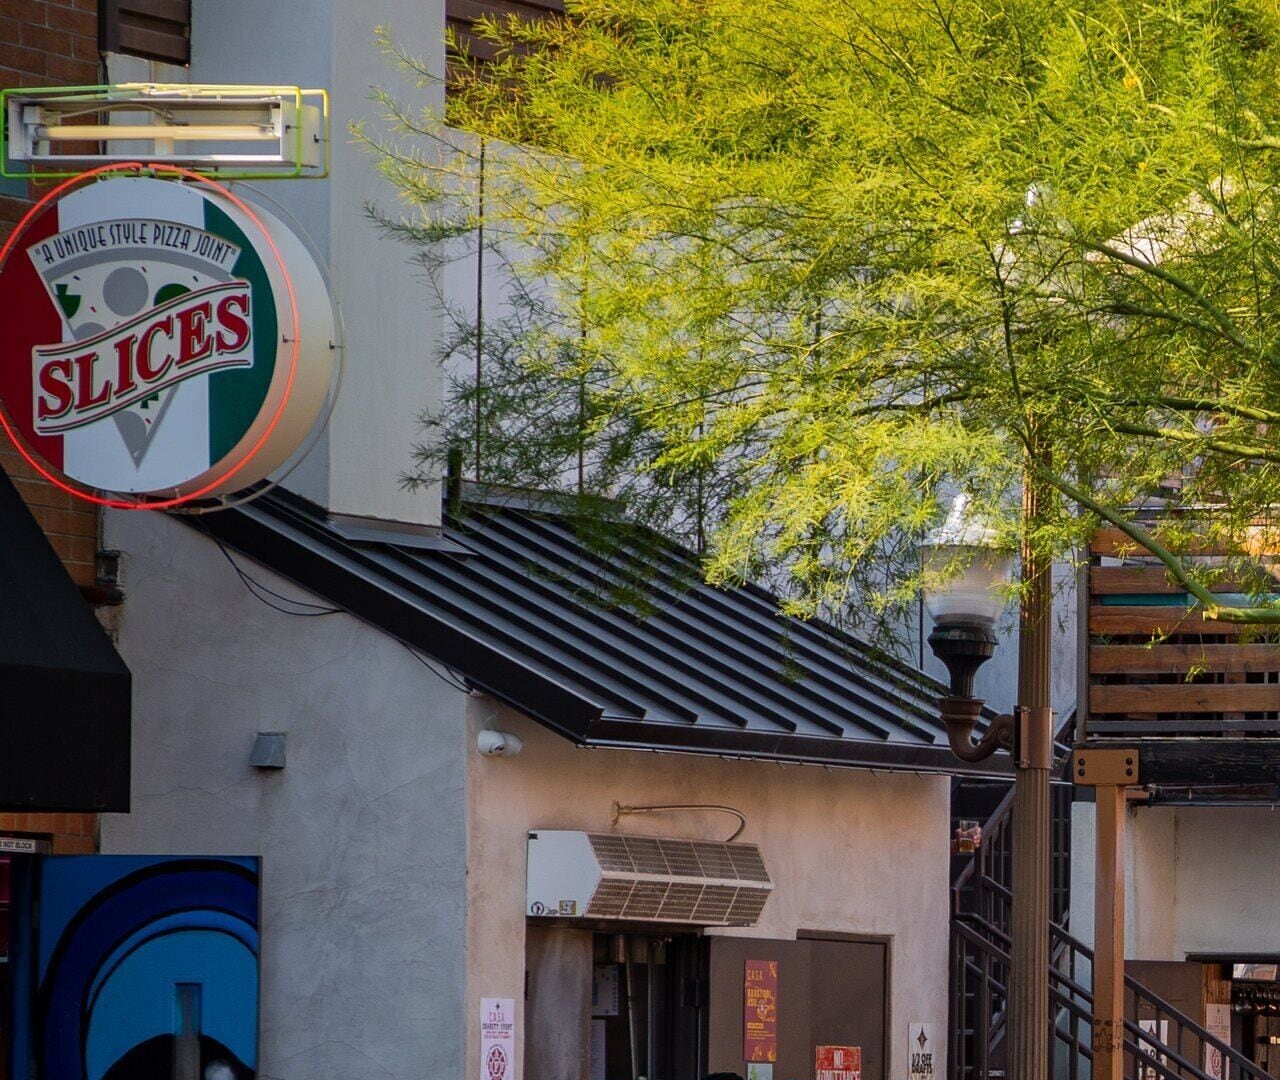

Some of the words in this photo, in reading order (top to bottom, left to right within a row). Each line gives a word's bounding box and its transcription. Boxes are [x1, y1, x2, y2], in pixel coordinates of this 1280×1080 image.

[53, 227, 107, 260] UNIQUE
[109, 223, 149, 246] STYLE
[152, 222, 191, 249] PIZZA
[192, 234, 237, 265] JOINT"
[38, 294, 250, 422] SLICES
[833, 1050, 844, 1069] NO
[921, 1053, 932, 1065] OFF
[911, 1064, 933, 1075] DRAFTS
